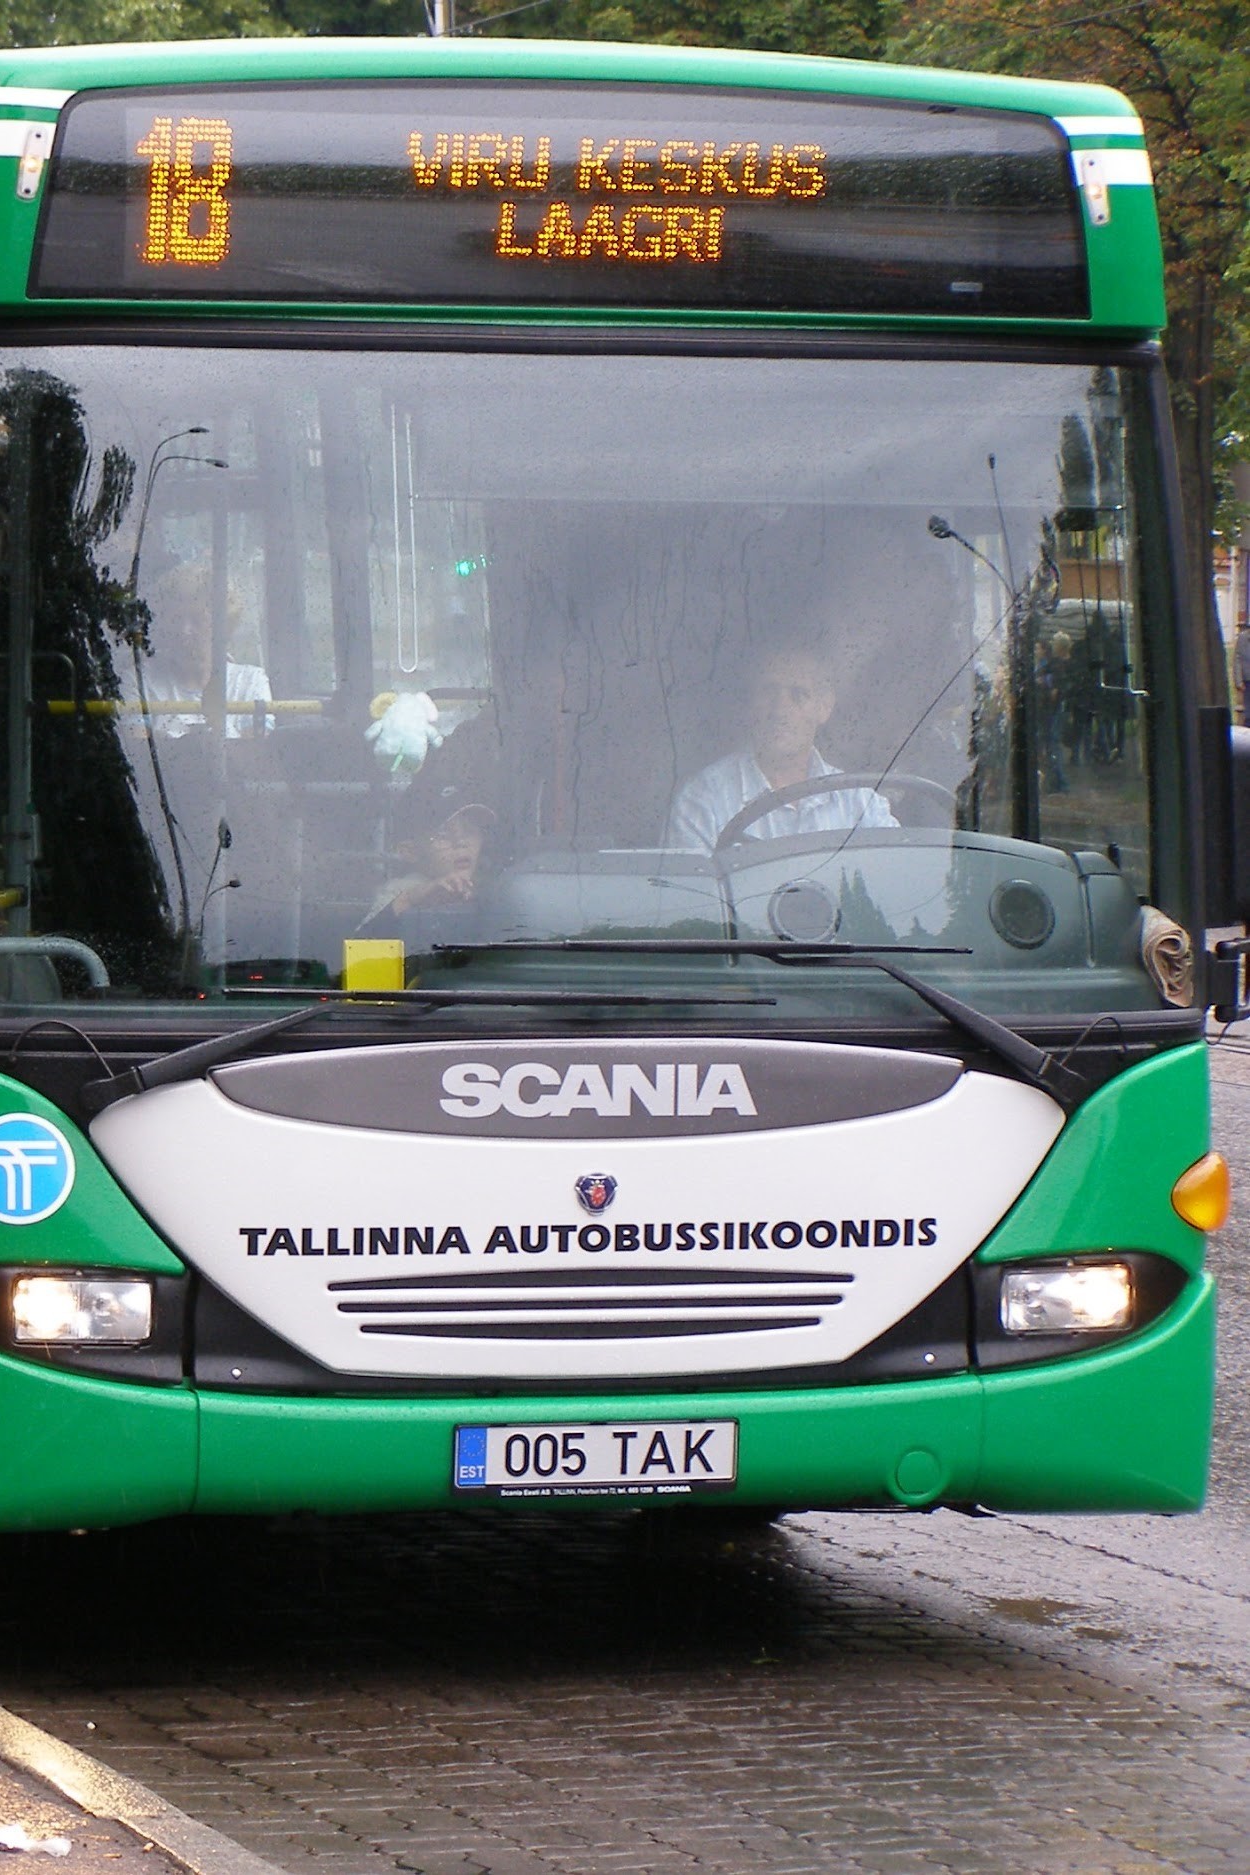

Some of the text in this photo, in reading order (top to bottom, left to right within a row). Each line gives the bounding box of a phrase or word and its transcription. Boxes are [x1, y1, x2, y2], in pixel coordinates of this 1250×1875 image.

[136, 116, 234, 263] 18
[406, 130, 828, 198] VIRU KESKUS
[494, 201, 726, 261] LAAGRI
[440, 1062, 758, 1118] SCANIA
[239, 1217, 937, 1256] TALLINNA AUTOBUSSIKOONDIS
[459, 1465, 485, 1479] EST
[504, 1429, 715, 1477] 005 TAK
[656, 1485, 692, 1494] SCANIA
